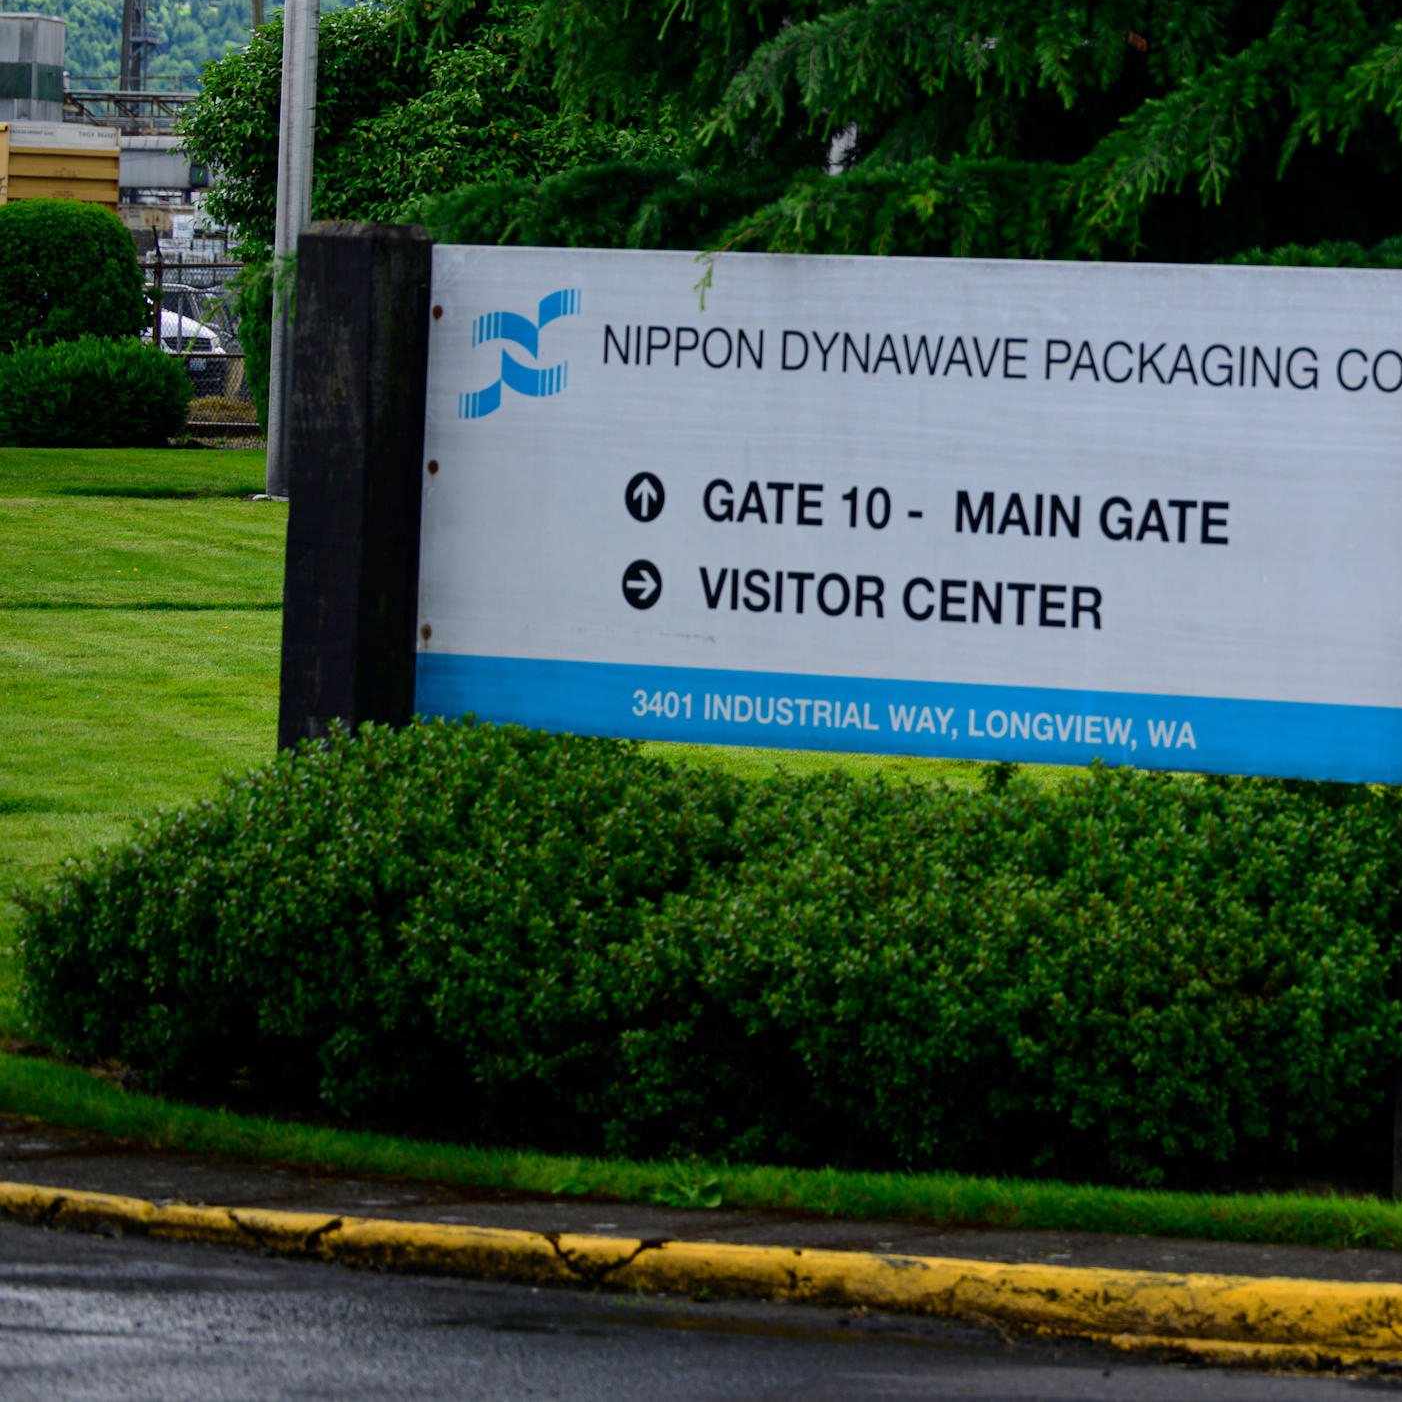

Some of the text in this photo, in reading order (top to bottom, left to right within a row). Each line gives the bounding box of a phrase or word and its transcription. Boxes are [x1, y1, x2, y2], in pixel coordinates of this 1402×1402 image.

[603, 323, 764, 370] NIPPON
[781, 329, 1029, 380] DYNAWAVE
[1045, 338, 1319, 390] PACKAGING
[703, 478, 824, 527] GATE
[841, 485, 892, 530] 10
[955, 489, 1081, 539] MAIN
[1099, 495, 1230, 546] GATE
[698, 566, 1103, 631] VISITOR CENTER
[632, 689, 1197, 751] 3401 INDUSTRIAL WAY, LONGVIEW, WA
